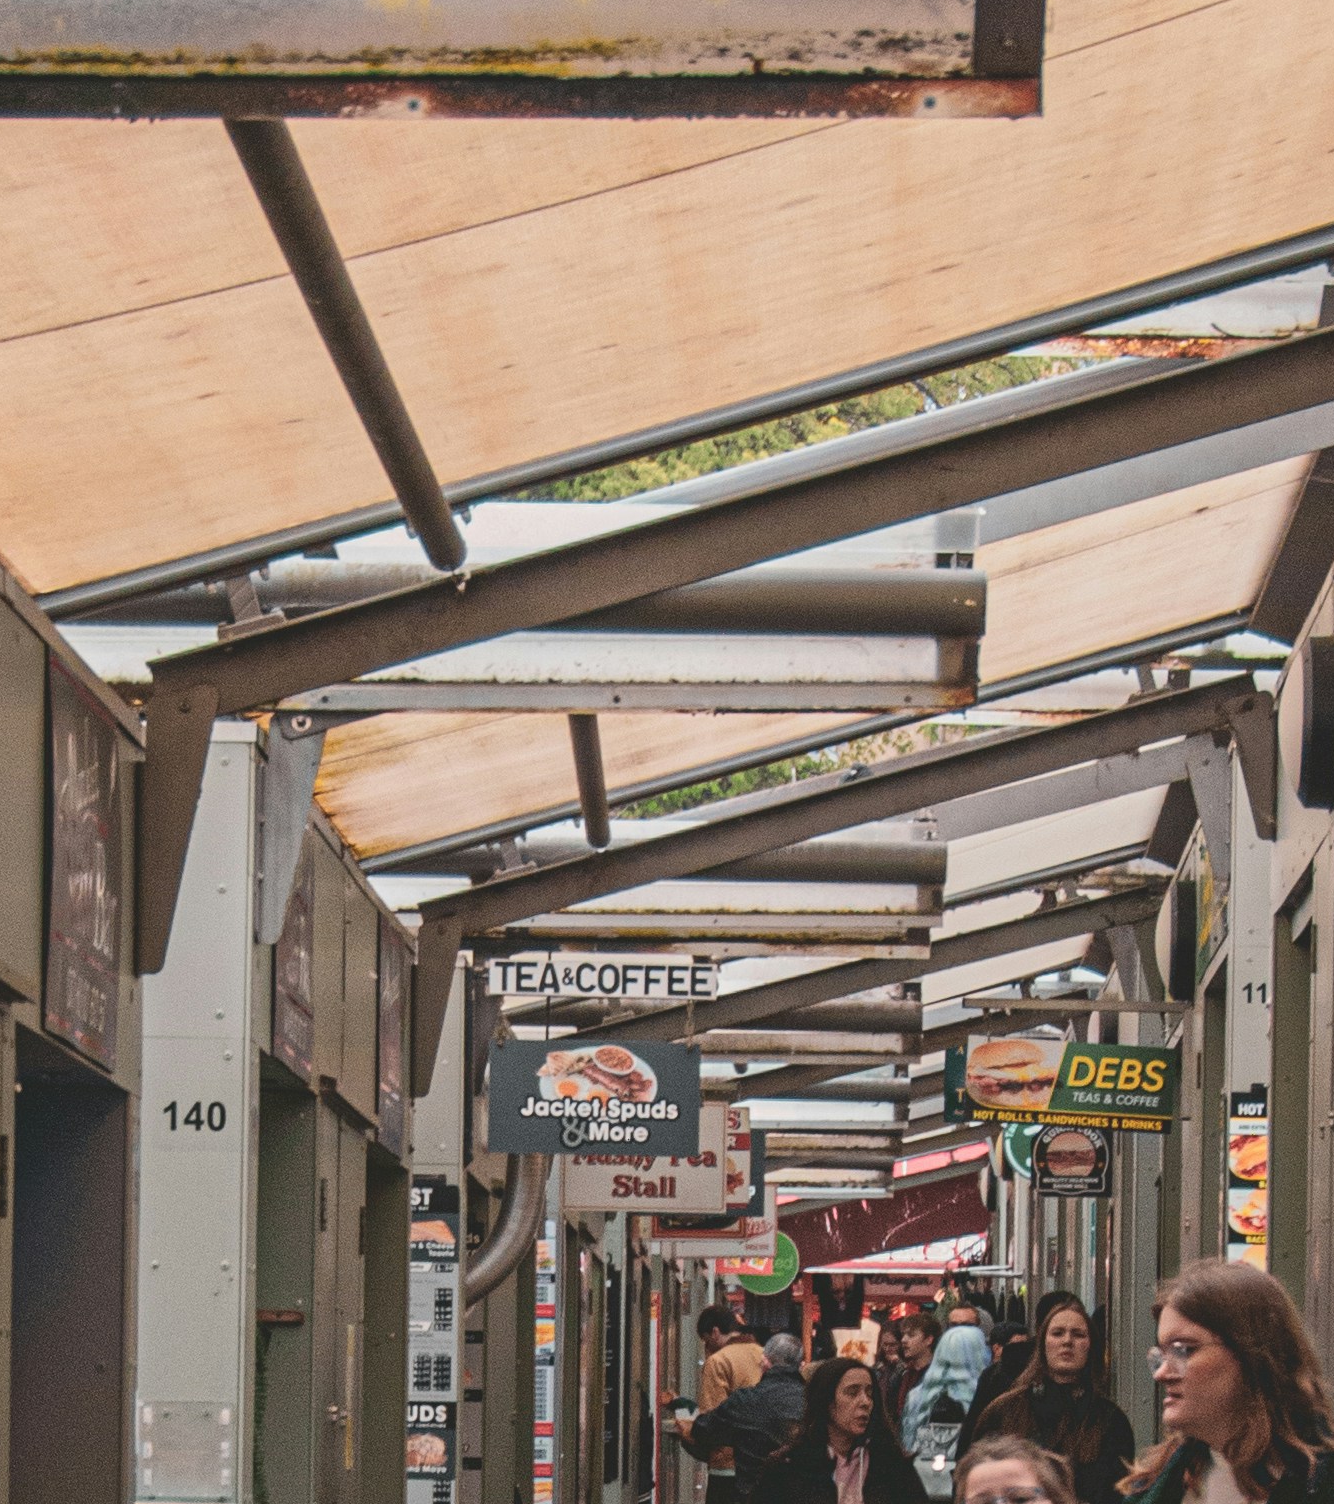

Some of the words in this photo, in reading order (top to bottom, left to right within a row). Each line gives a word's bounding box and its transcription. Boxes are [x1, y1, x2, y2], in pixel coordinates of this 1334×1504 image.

[1066, 1055, 1166, 1092] DEBS
[521, 1097, 602, 1118] Jacket
[607, 1099, 679, 1122] Spuds
[1072, 1091, 1100, 1104] TEAS
[1104, 1093, 1112, 1104] &
[1116, 1094, 1160, 1107] COFFEE
[1238, 1103, 1265, 1116] HOT
[162, 1100, 227, 1132] 140
[974, 1110, 994, 1120] HOT
[1038, 1113, 1108, 1128] SANDWICHES
[1111, 1119, 1119, 1128] &
[1122, 1120, 1162, 1131] DRINKS
[561, 1117, 586, 1146] &
[589, 1122, 648, 1142] More
[612, 1174, 676, 1198] Stall
